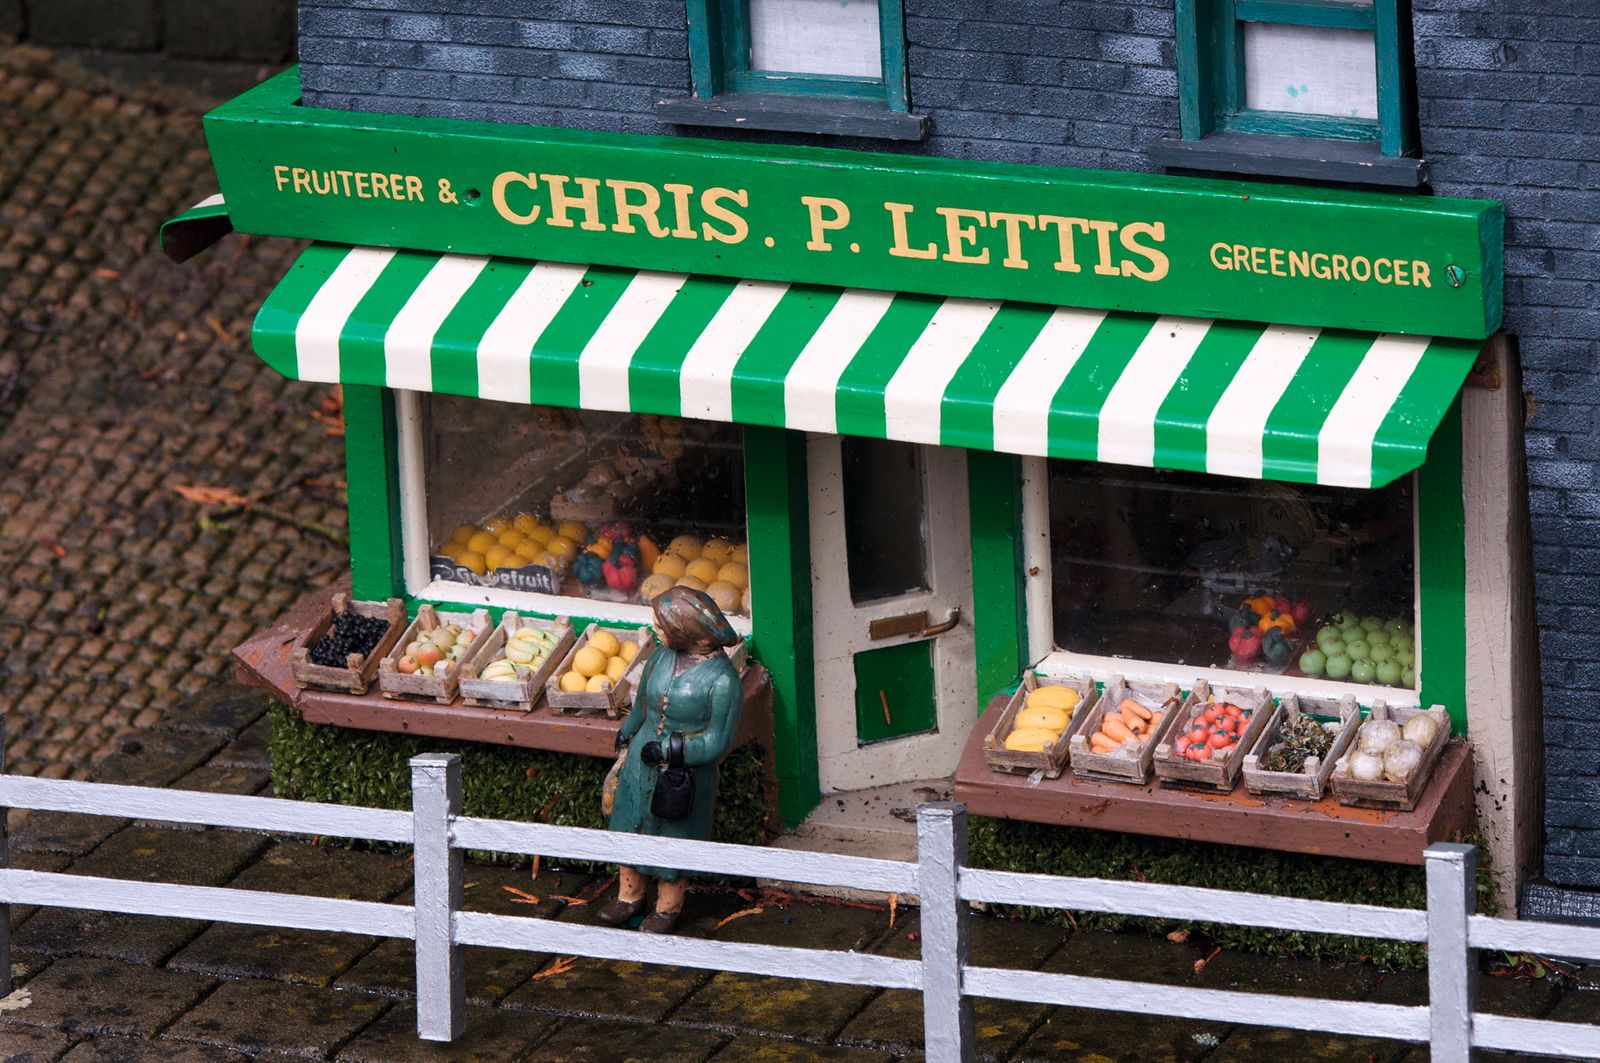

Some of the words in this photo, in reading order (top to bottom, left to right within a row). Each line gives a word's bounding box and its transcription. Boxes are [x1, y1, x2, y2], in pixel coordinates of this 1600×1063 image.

[273, 165, 425, 203] FRUITERER
[437, 177, 460, 206] &
[801, 195, 862, 254] P.
[883, 201, 1171, 283] LETTIS
[1209, 241, 1433, 289] GREENGROCER
[456, 567, 551, 592] Grefruit
